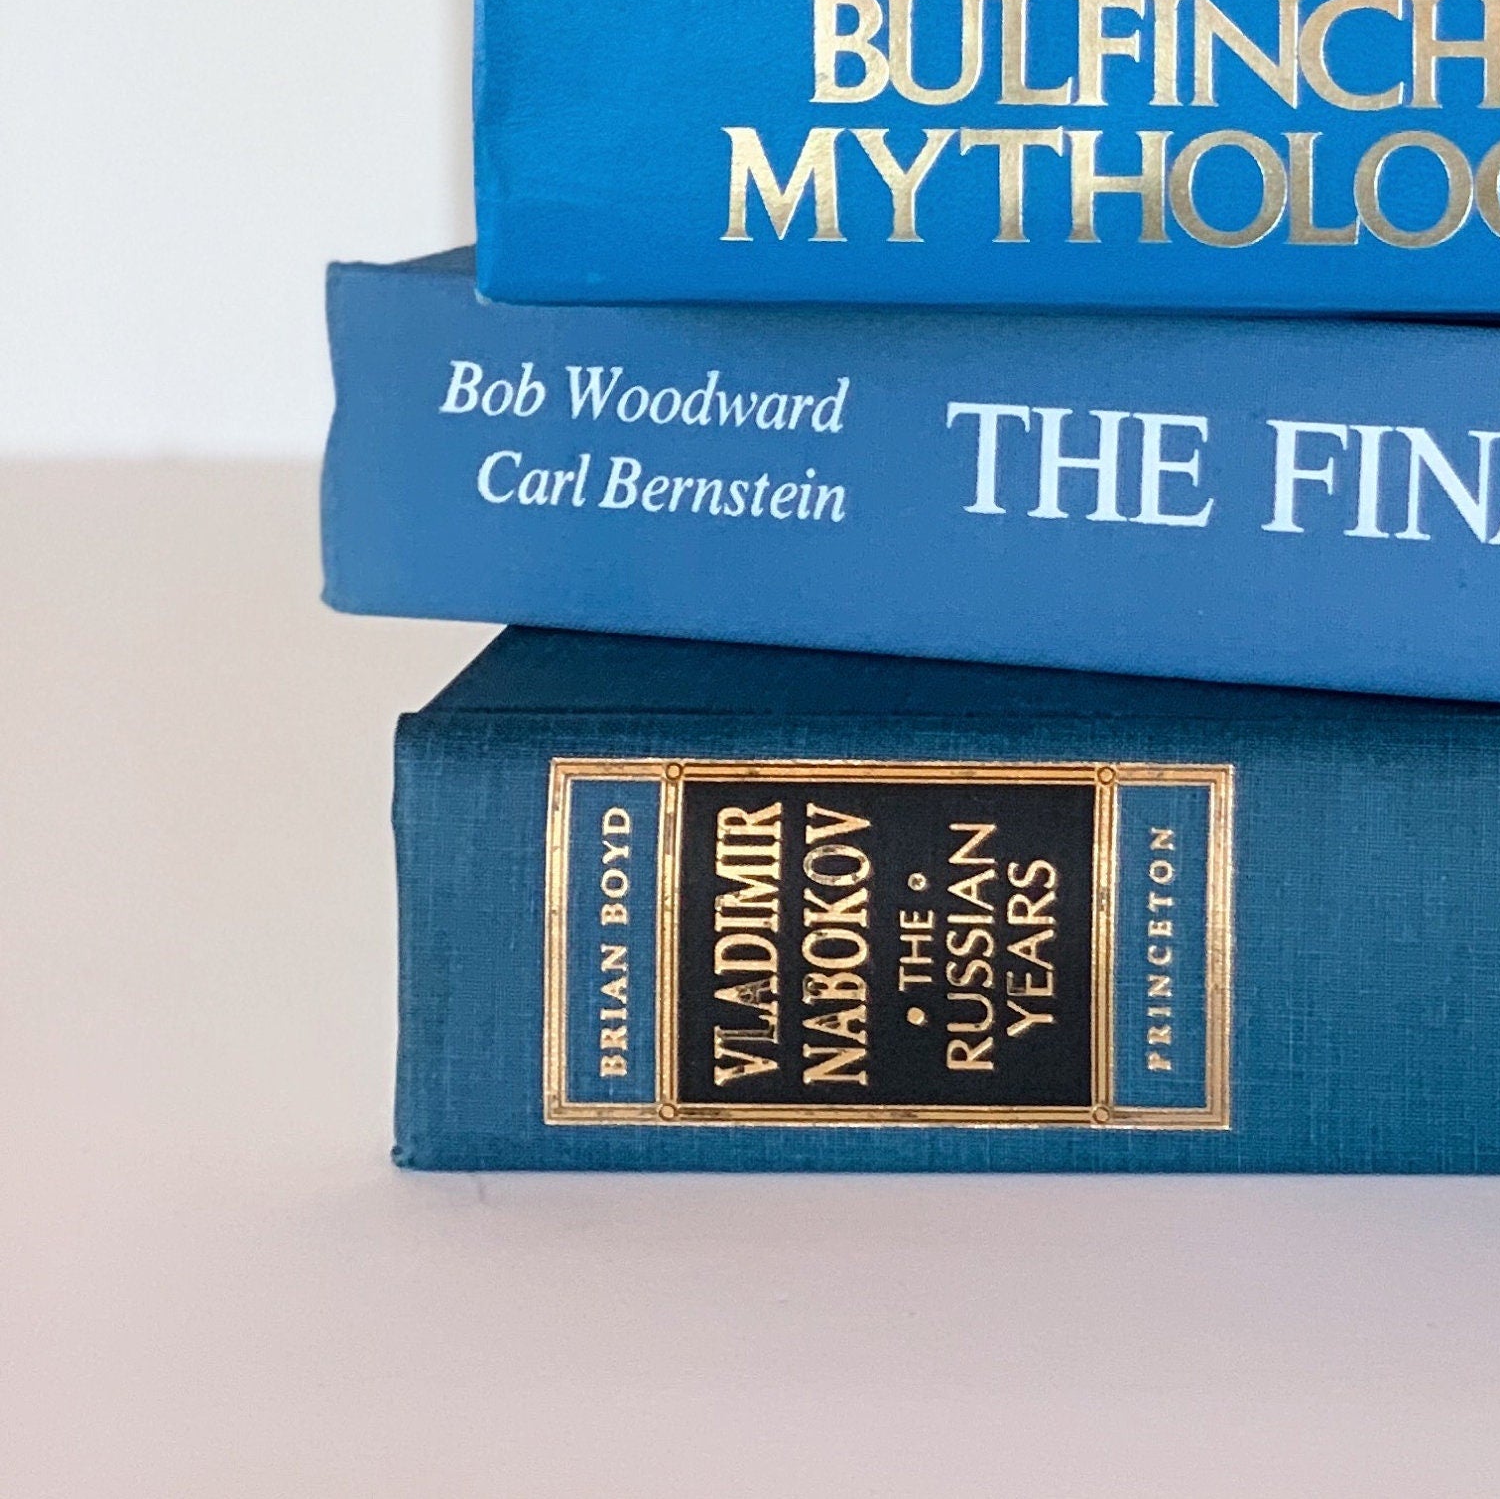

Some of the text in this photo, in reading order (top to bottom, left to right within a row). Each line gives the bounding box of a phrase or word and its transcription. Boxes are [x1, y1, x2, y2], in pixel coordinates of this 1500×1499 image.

[440, 359, 850, 433] Bob Woodward
[476, 450, 846, 522] Carl Bernstein
[946, 401, 1214, 528] THE
[600, 806, 631, 1078] BRIAN BOYD
[714, 800, 782, 1086] VLADIMIR
[802, 803, 871, 1085] NABOKOV
[899, 909, 934, 990] THE
[945, 822, 996, 1072] RUSSIAN
[1006, 859, 1058, 1037] YEARS
[1148, 827, 1174, 1072] PRINCETON
